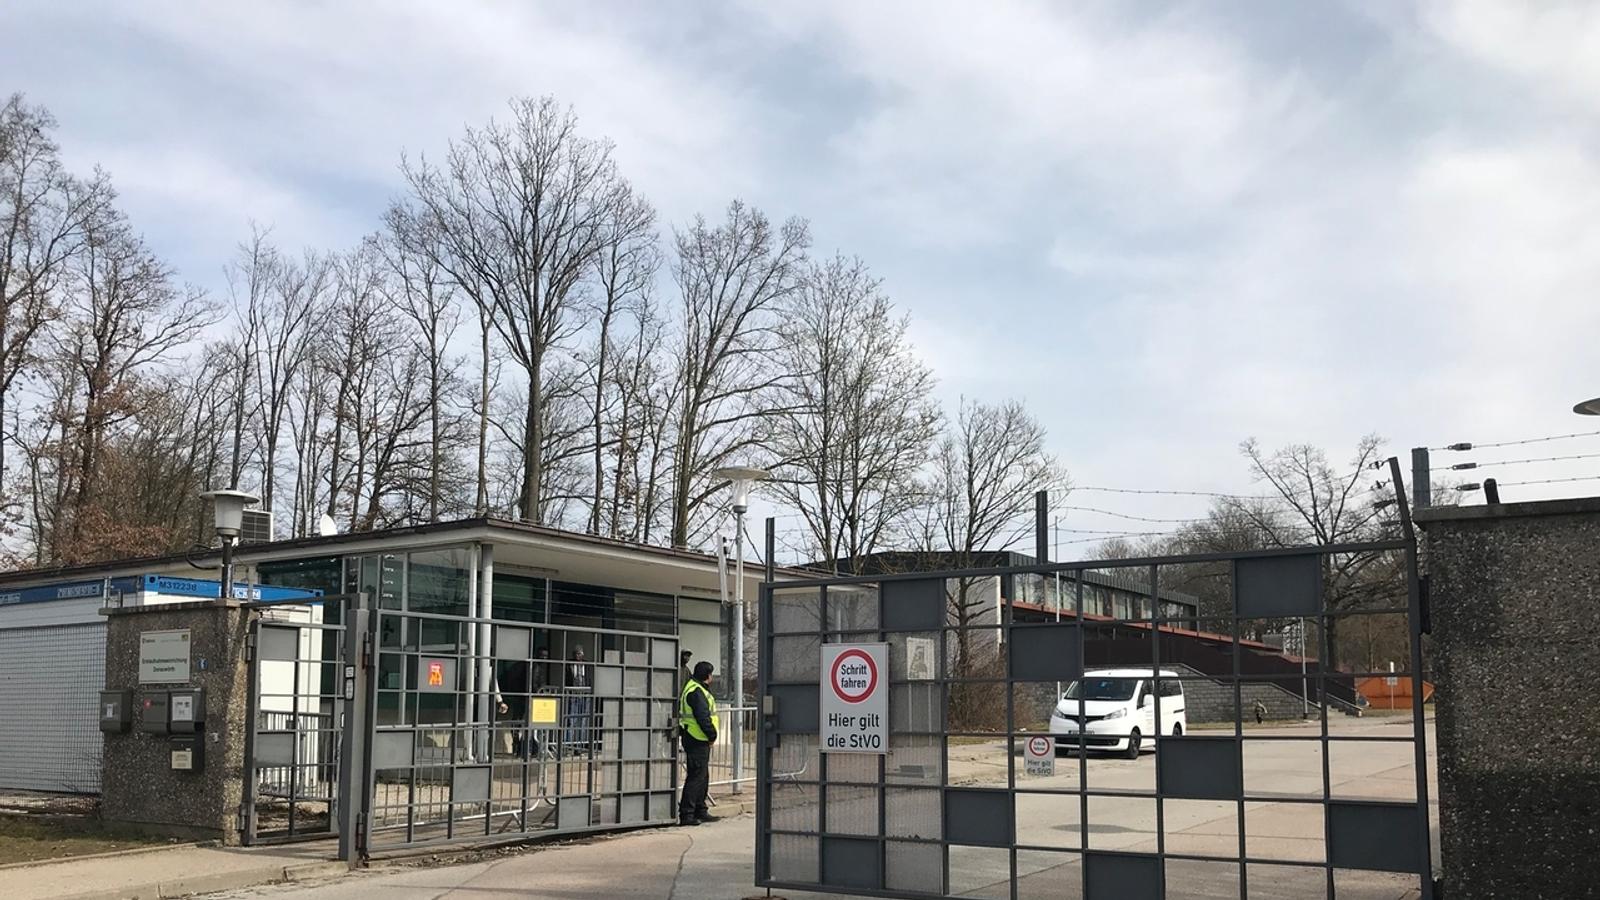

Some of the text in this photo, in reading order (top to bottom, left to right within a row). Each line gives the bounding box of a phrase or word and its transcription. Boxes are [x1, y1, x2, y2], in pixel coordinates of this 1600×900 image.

[841, 664, 867, 675] Schritt
[841, 677, 867, 688] fahren
[828, 713, 880, 731] Hier gilt
[827, 733, 881, 749] die StVO
